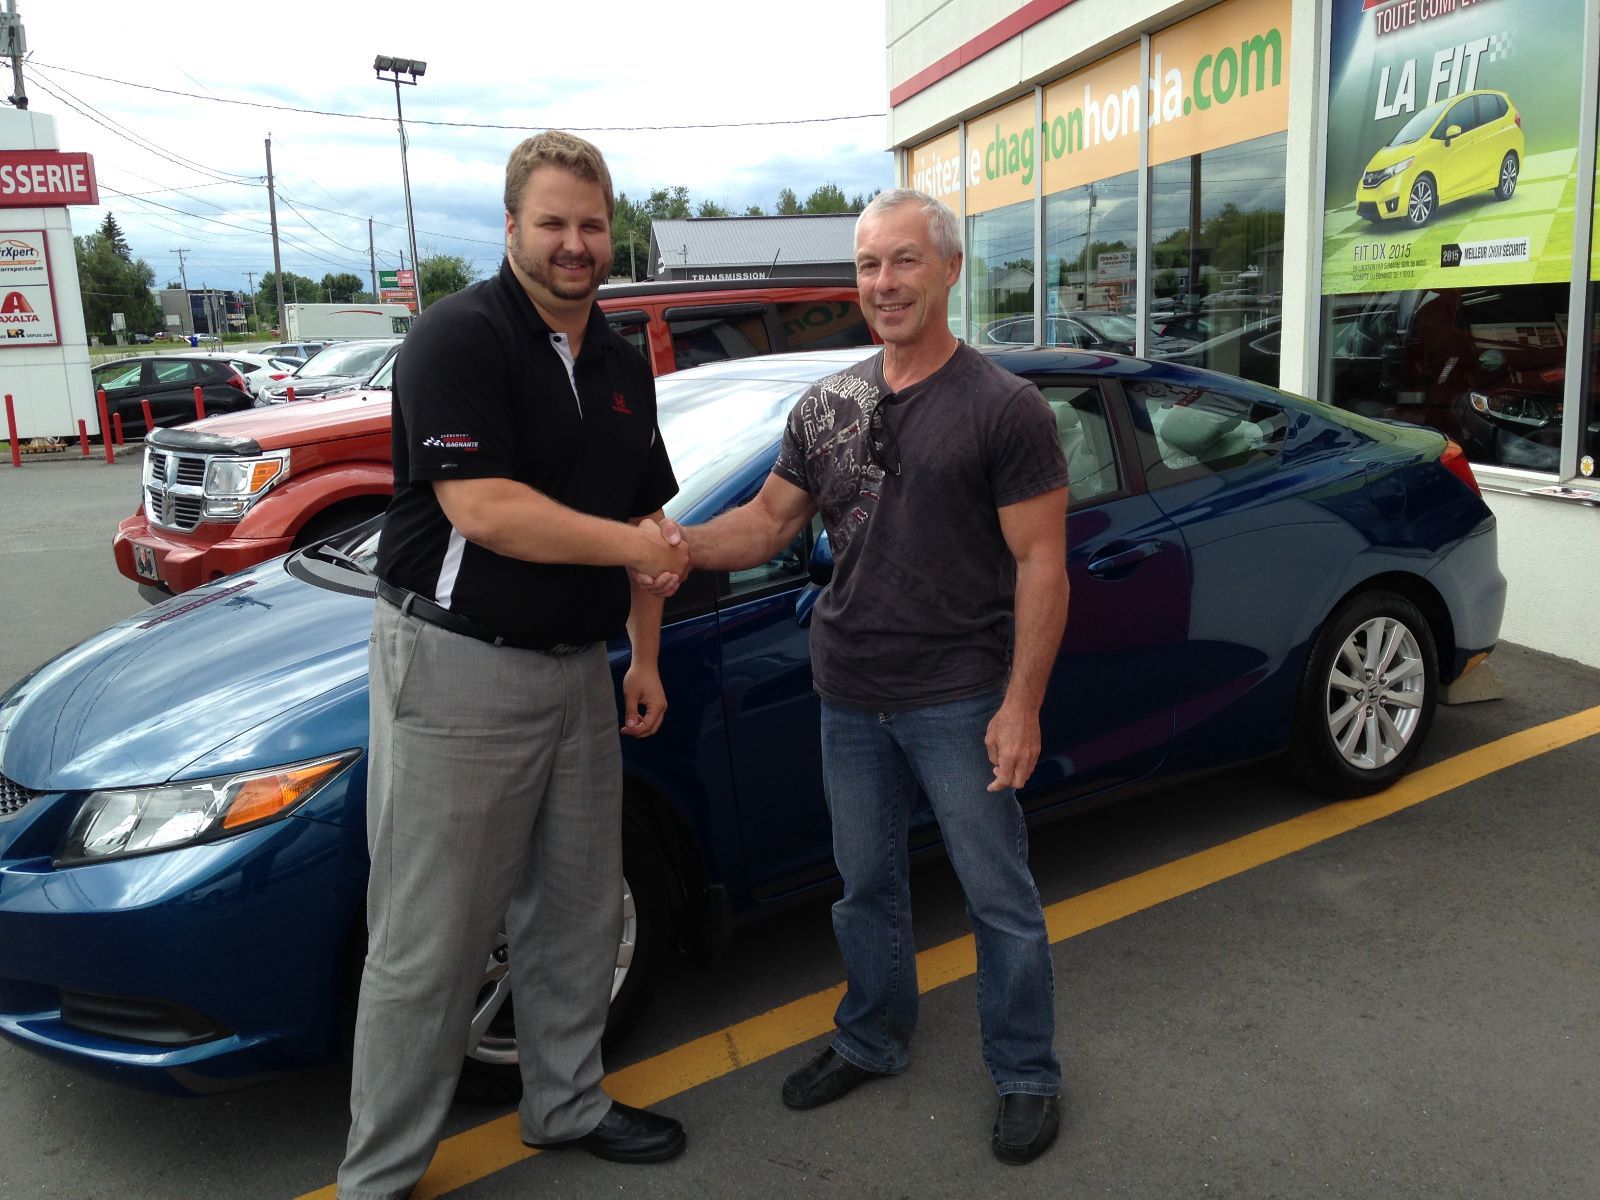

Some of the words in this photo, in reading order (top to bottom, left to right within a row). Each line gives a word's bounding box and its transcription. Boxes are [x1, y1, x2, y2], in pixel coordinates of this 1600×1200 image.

[1376, 0, 1416, 35] TOUTE
[1374, 58, 1417, 121] LA
[1426, 36, 1491, 108] FIT
[0, 164, 87, 194] SSERIE
[0, 246, 34, 260] rXpert
[1354, 245, 1369, 261] FIT
[1372, 243, 1387, 261] DX
[1388, 243, 1412, 260] 2015
[1442, 249, 1459, 262] 2015
[1464, 246, 1488, 260] MEILLEUR
[1502, 240, 1527, 257] SÉCURITÉ
[691, 272, 766, 281] TRANSMISSION
